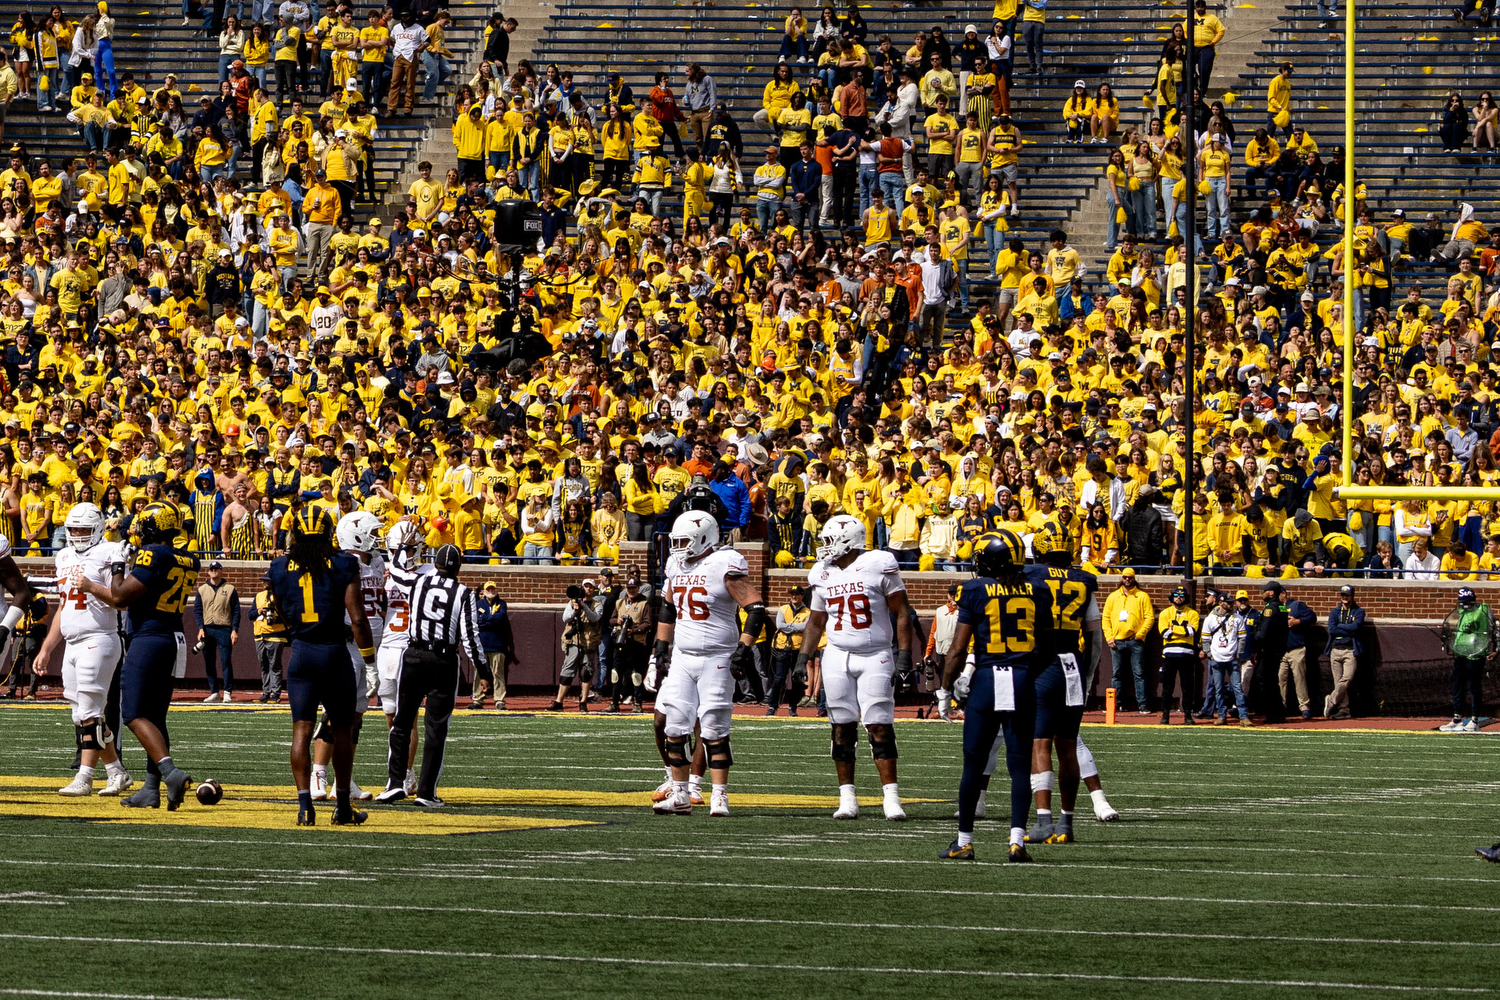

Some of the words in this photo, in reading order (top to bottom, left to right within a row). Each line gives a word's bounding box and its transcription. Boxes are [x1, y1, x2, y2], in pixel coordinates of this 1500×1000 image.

[337, 31, 353, 39] 2023
[396, 33, 413, 41] TEXAS
[447, 190, 457, 198] M
[984, 196, 998, 204] M
[677, 304, 687, 314] M
[316, 316, 331, 328] 20
[790, 382, 801, 392] M
[770, 401, 781, 412] M
[1204, 398, 1220, 411] M
[488, 476, 509, 484] 2023
[403, 505, 419, 515] M
[1090, 534, 1102, 552] 9
[137, 550, 153, 566] 26
[60, 564, 86, 576] TEXAS
[1047, 568, 1068, 578] GUY
[675, 575, 706, 585] TEXAS
[156, 566, 199, 613] 26
[827, 582, 864, 594] TEXAS
[298, 572, 318, 622] 1
[423, 588, 448, 621] C
[672, 586, 710, 620] 76
[389, 600, 409, 632] 3
[828, 594, 872, 631] 78
[984, 597, 1036, 654] 13
[177, 635, 184, 643] M
[1064, 662, 1075, 671] M
